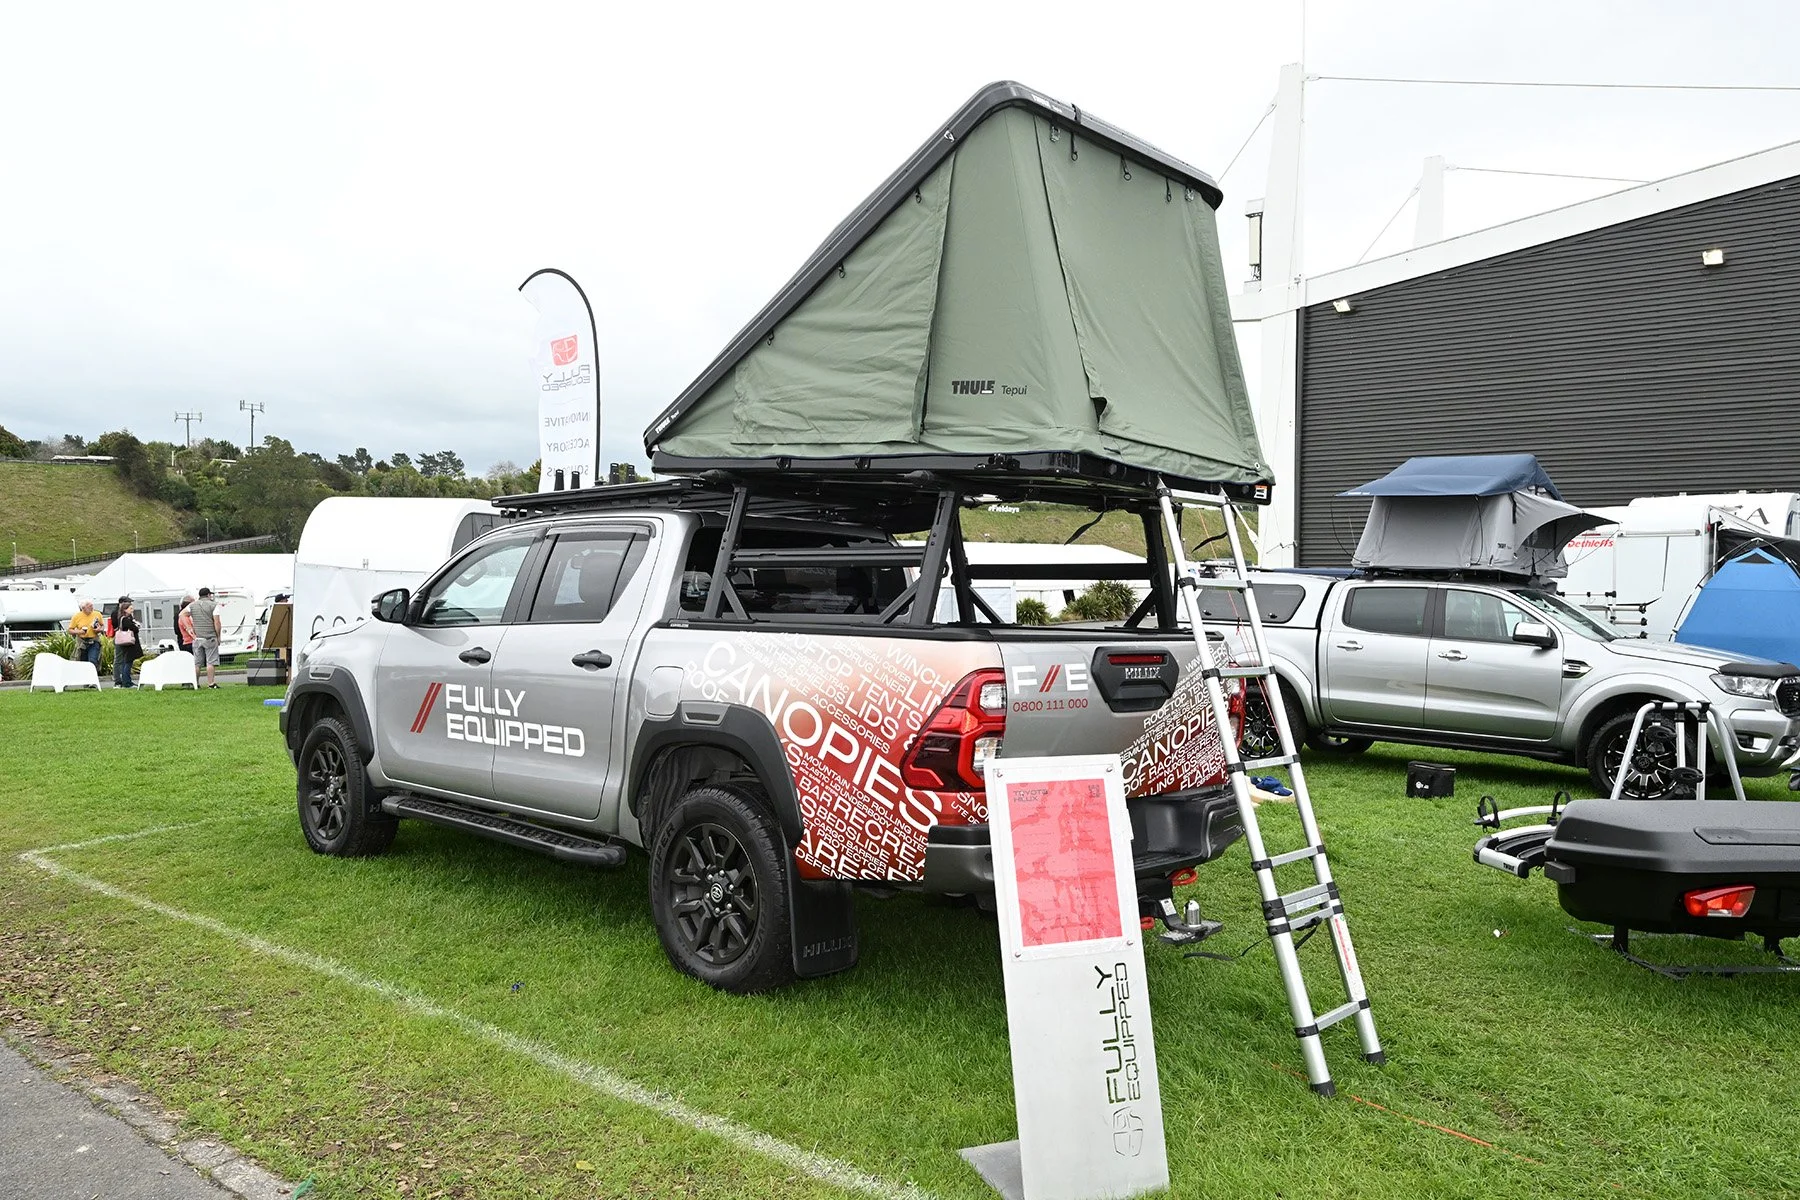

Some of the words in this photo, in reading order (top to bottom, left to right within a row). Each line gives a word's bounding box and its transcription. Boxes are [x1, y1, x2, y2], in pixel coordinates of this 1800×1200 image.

[951, 380, 995, 394] THULE
[1001, 385, 1027, 396] Tepui
[1568, 539, 1614, 548] Dethleffs
[795, 664, 847, 706] SHIELDS
[833, 640, 874, 673] BEDRUG
[874, 668, 907, 697] LINER
[882, 660, 912, 685] COVER
[1125, 667, 1161, 680] HILUX
[445, 683, 526, 717] FULLY
[773, 665, 811, 696] VEHICLE
[811, 692, 891, 755] ACCESSORIES
[844, 691, 899, 741] LIDS
[857, 673, 923, 732] TENTS
[1012, 700, 1043, 712] 0800
[1046, 700, 1065, 711] 111
[1068, 698, 1088, 710] 000
[1143, 692, 1187, 729] ROOFTOP
[1189, 686, 1210, 709] LIDS
[446, 712, 585, 757] EQUIPPED
[703, 641, 942, 833] CANOPIES
[1120, 740, 1150, 763] REMIUM
[1151, 719, 1181, 743] VEHICLE
[1122, 704, 1217, 784] CANOPIE
[1133, 720, 1165, 747] WEATHER
[800, 760, 830, 783] PLASTIC
[829, 779, 842, 793] LID
[1124, 772, 1147, 797] OOF
[1148, 746, 1185, 779] RACKS
[1175, 756, 1197, 779] LIDS
[1180, 752, 1223, 790] FLARES
[799, 775, 833, 808] BAR
[803, 752, 851, 789] MOUNTAIN
[852, 785, 871, 803] TOP
[871, 802, 913, 834] ROLLING
[840, 788, 892, 829] UNDERBODY
[950, 801, 969, 818] UTE
[813, 818, 845, 843] CARGO
[845, 840, 887, 870] BARRIER
[816, 805, 891, 863] BEDSLIDE
[816, 829, 886, 877] PROTECTOR
[1094, 965, 1126, 1104] FULLY
[1114, 962, 1141, 1101] EQUIPPED
